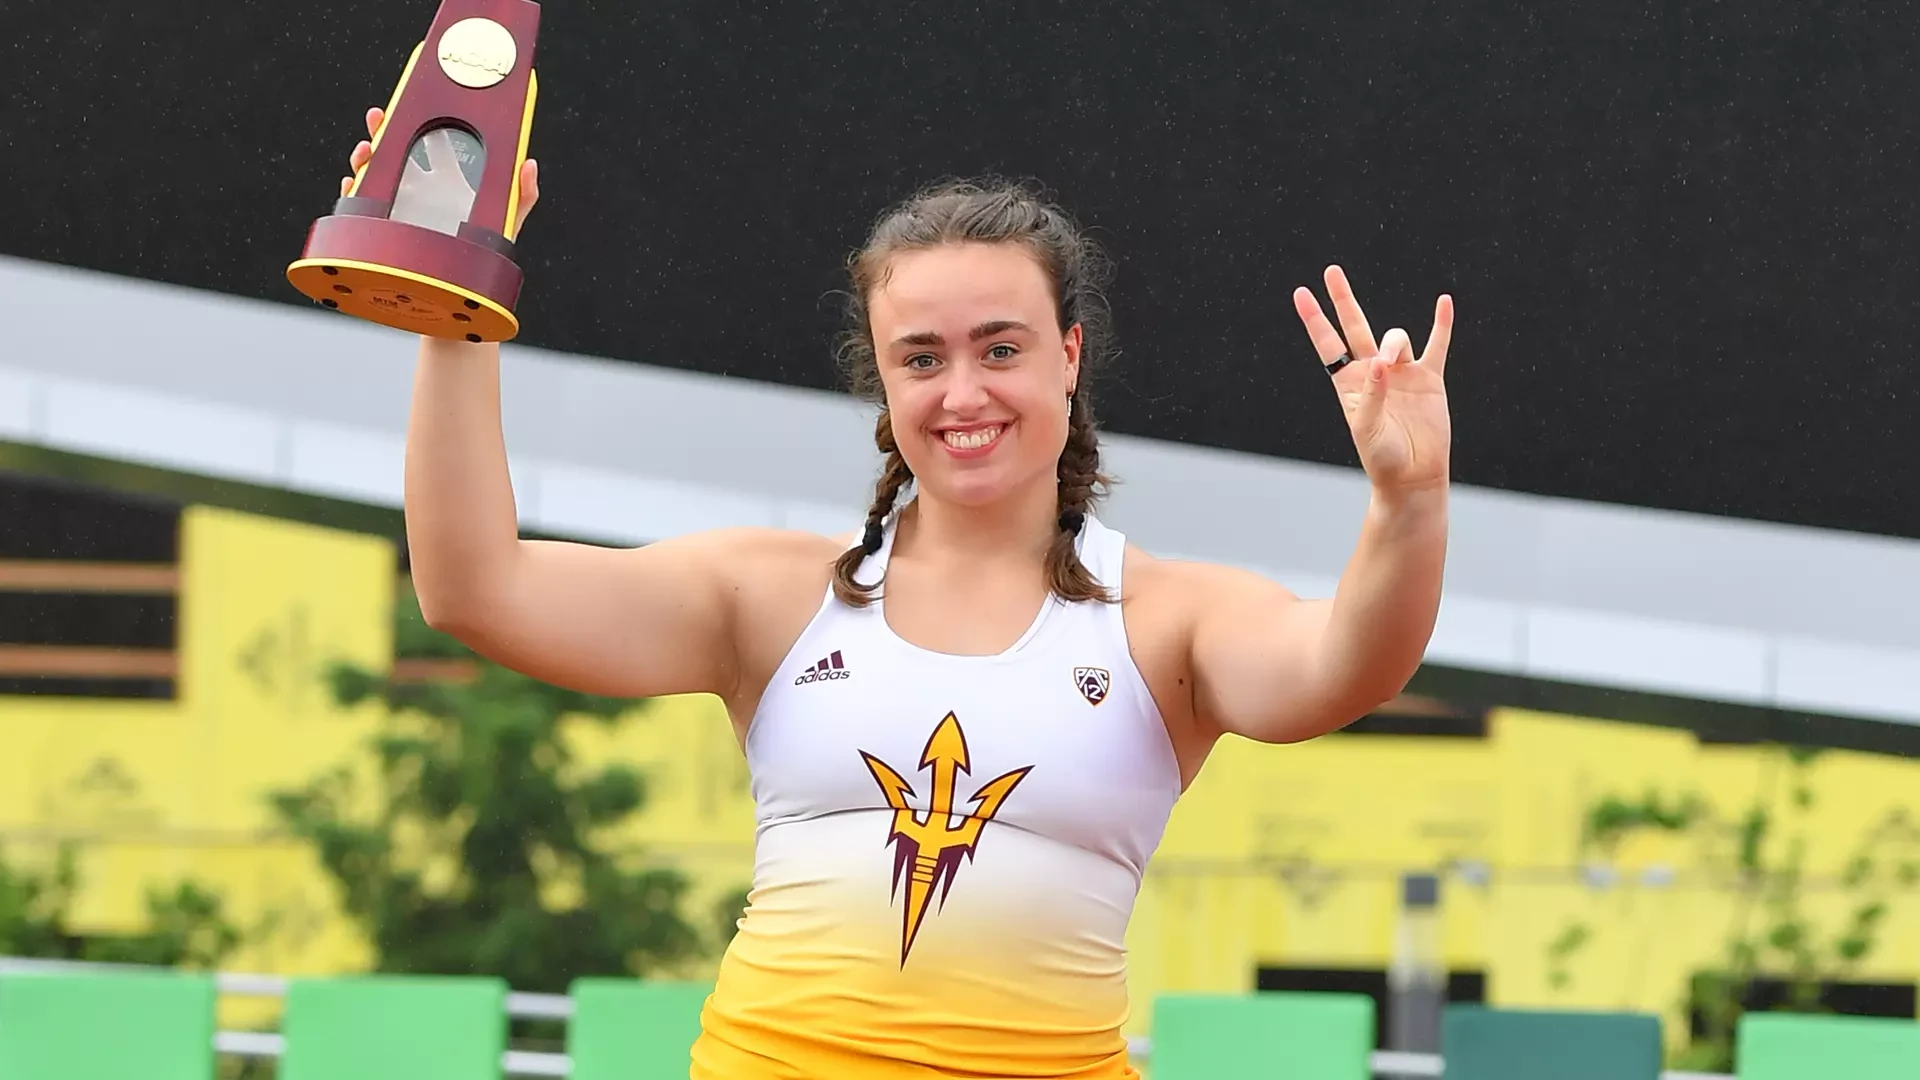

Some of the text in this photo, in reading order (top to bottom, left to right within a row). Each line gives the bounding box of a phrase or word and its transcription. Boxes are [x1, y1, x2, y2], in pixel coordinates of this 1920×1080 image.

[795, 669, 851, 686] adidas
[1075, 668, 1109, 693] PAC
[1084, 683, 1102, 700] 12
